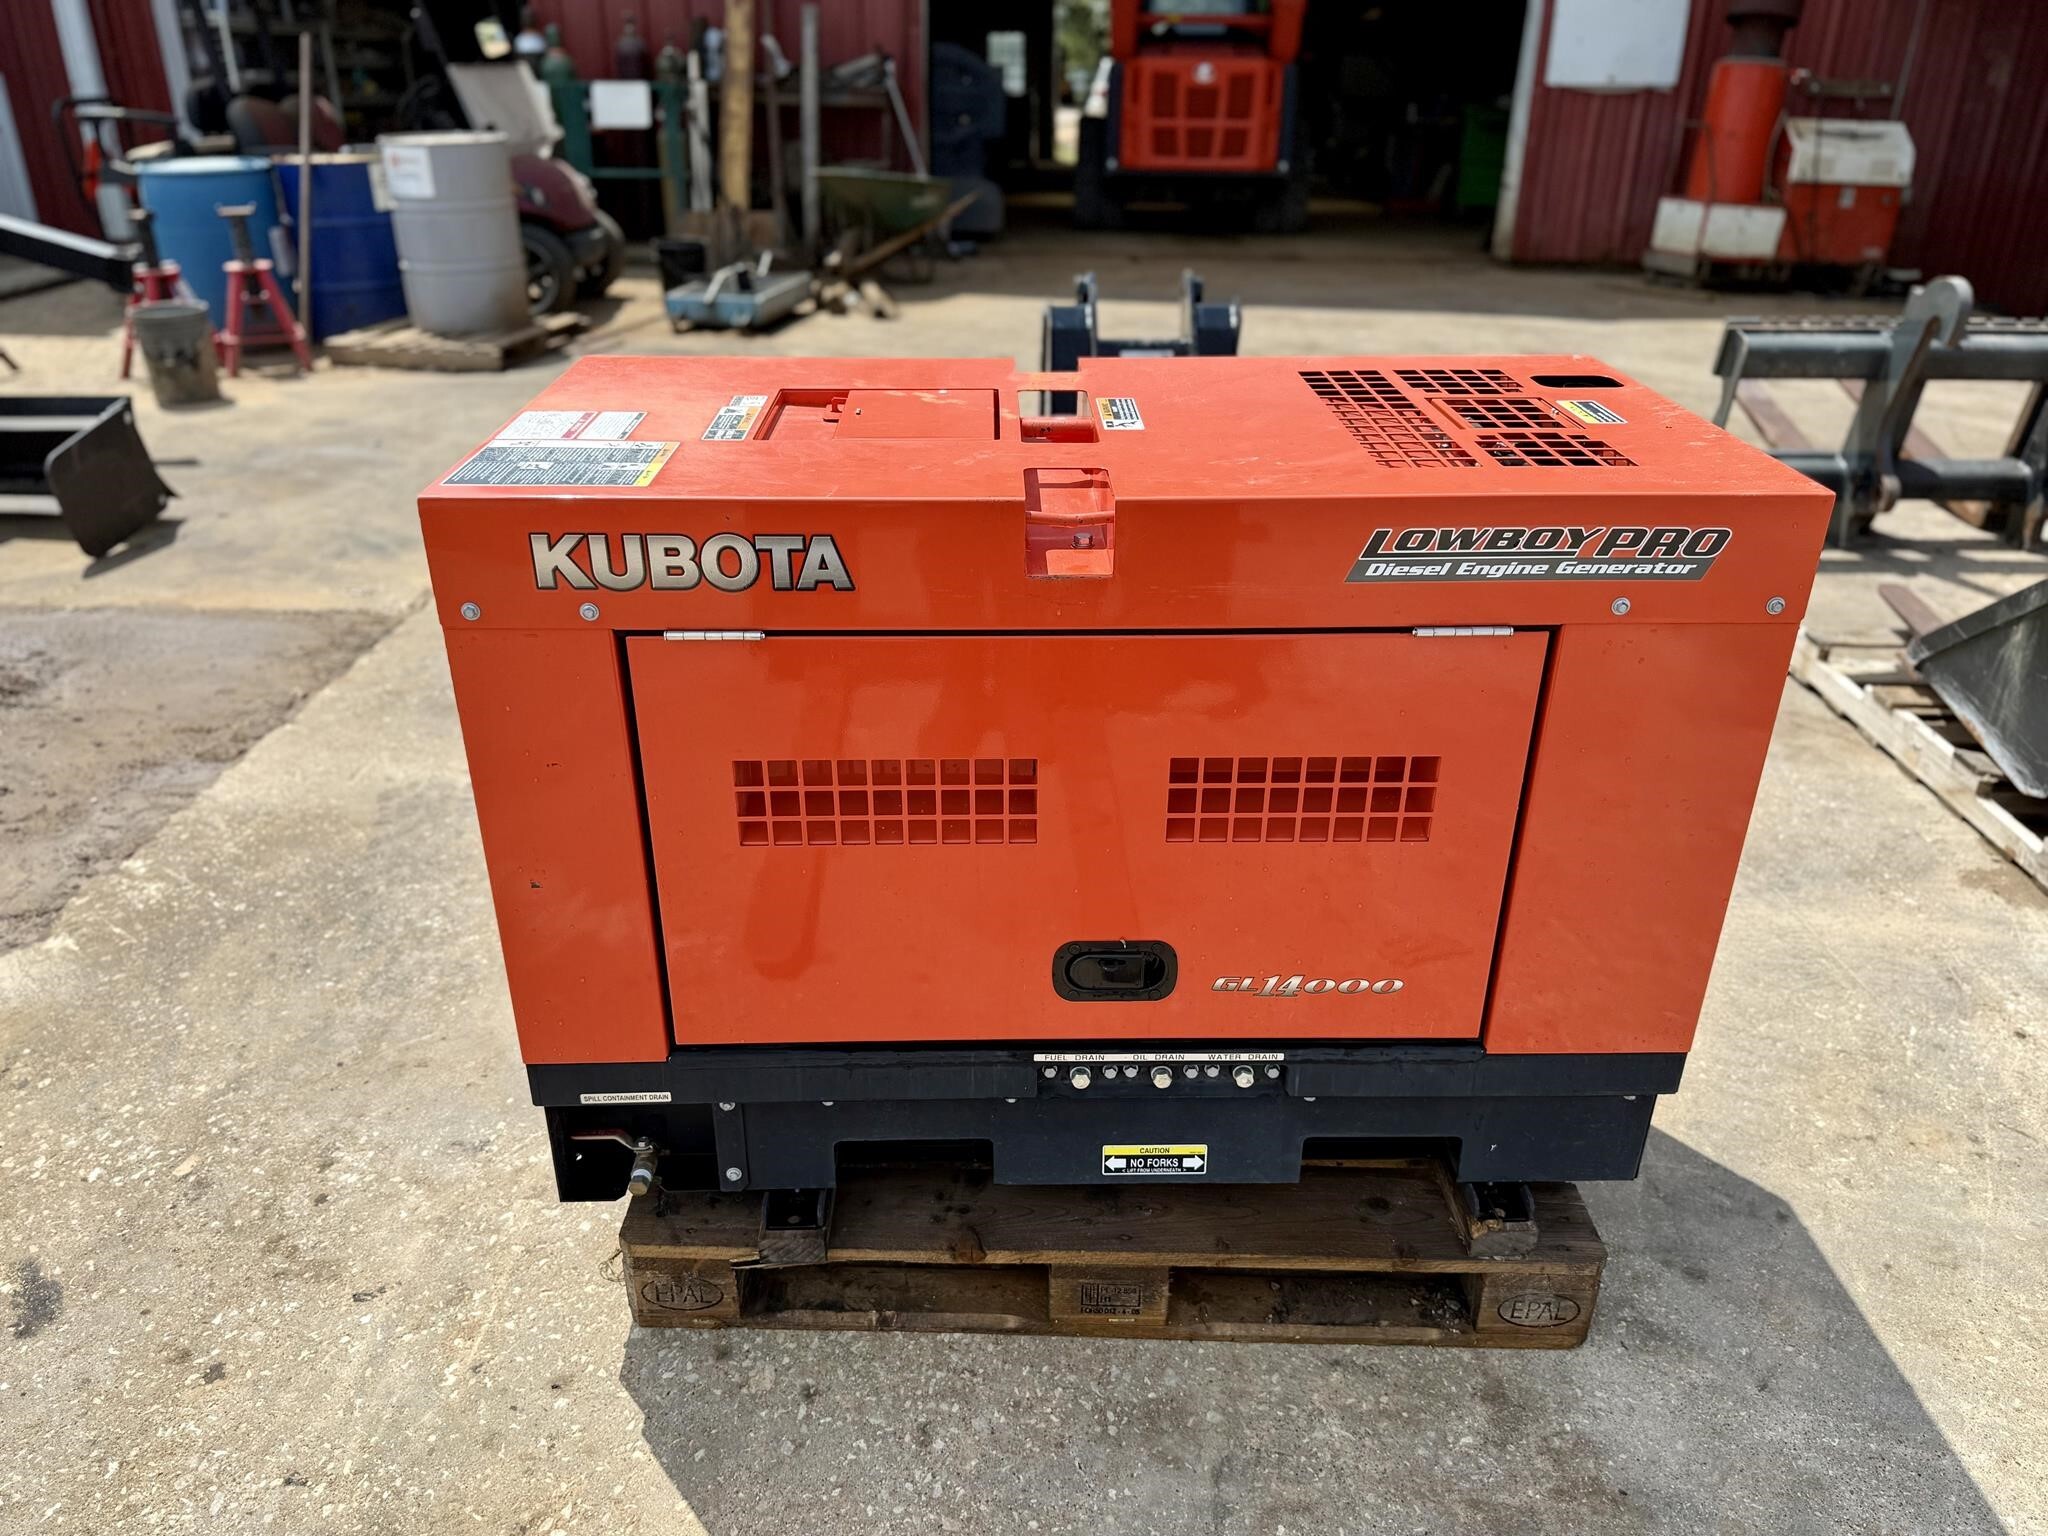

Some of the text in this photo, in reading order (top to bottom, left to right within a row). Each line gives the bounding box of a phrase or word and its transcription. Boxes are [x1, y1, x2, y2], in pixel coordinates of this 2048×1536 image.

[528, 532, 855, 592] KUBOTA
[1365, 561, 1698, 578] Diesel Engine Generator
[1211, 974, 1404, 998] GL14000
[602, 1094, 647, 1102] CONTAINMENT
[1130, 1158, 1179, 1168] NO FORKS
[655, 1283, 713, 1303] EPAL
[1510, 1300, 1567, 1320] EPAL
